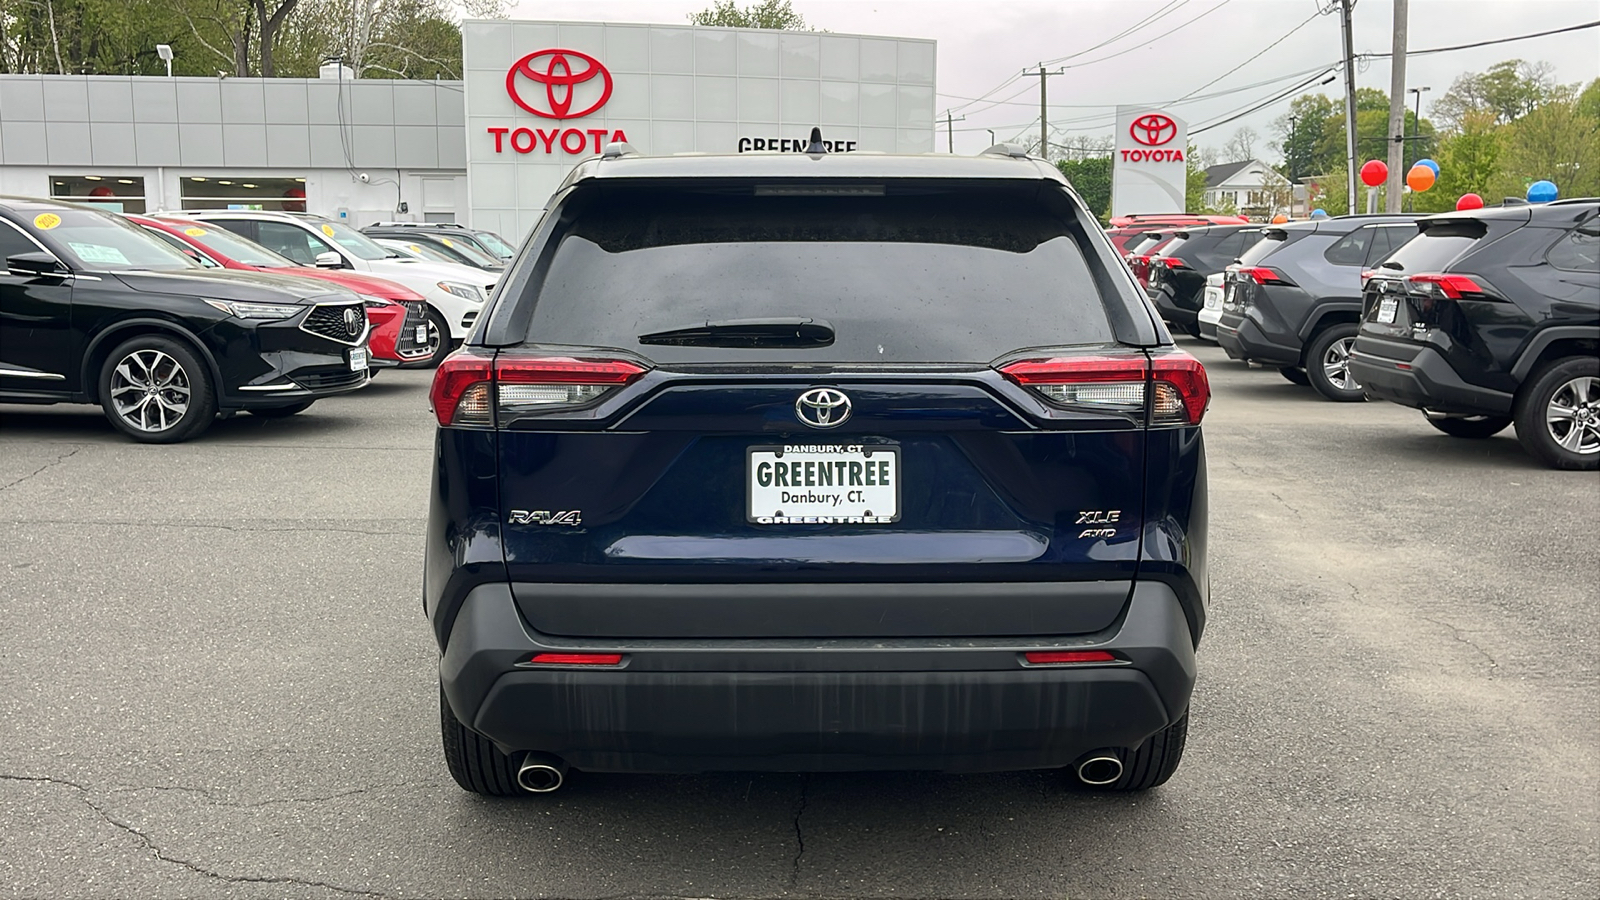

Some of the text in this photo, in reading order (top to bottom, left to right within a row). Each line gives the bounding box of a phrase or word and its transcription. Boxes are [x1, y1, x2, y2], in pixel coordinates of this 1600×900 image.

[738, 137, 857, 154] GREENREE
[1120, 149, 1184, 162] TOYOTA
[783, 444, 864, 454] DANBURY, CT
[757, 460, 890, 488] GREENTREE
[781, 490, 866, 507] Danbury, CT.
[508, 509, 582, 526] RAV4
[756, 516, 892, 525] GREENTREE
[1075, 510, 1121, 524] XLE
[1078, 528, 1117, 538] AWD
